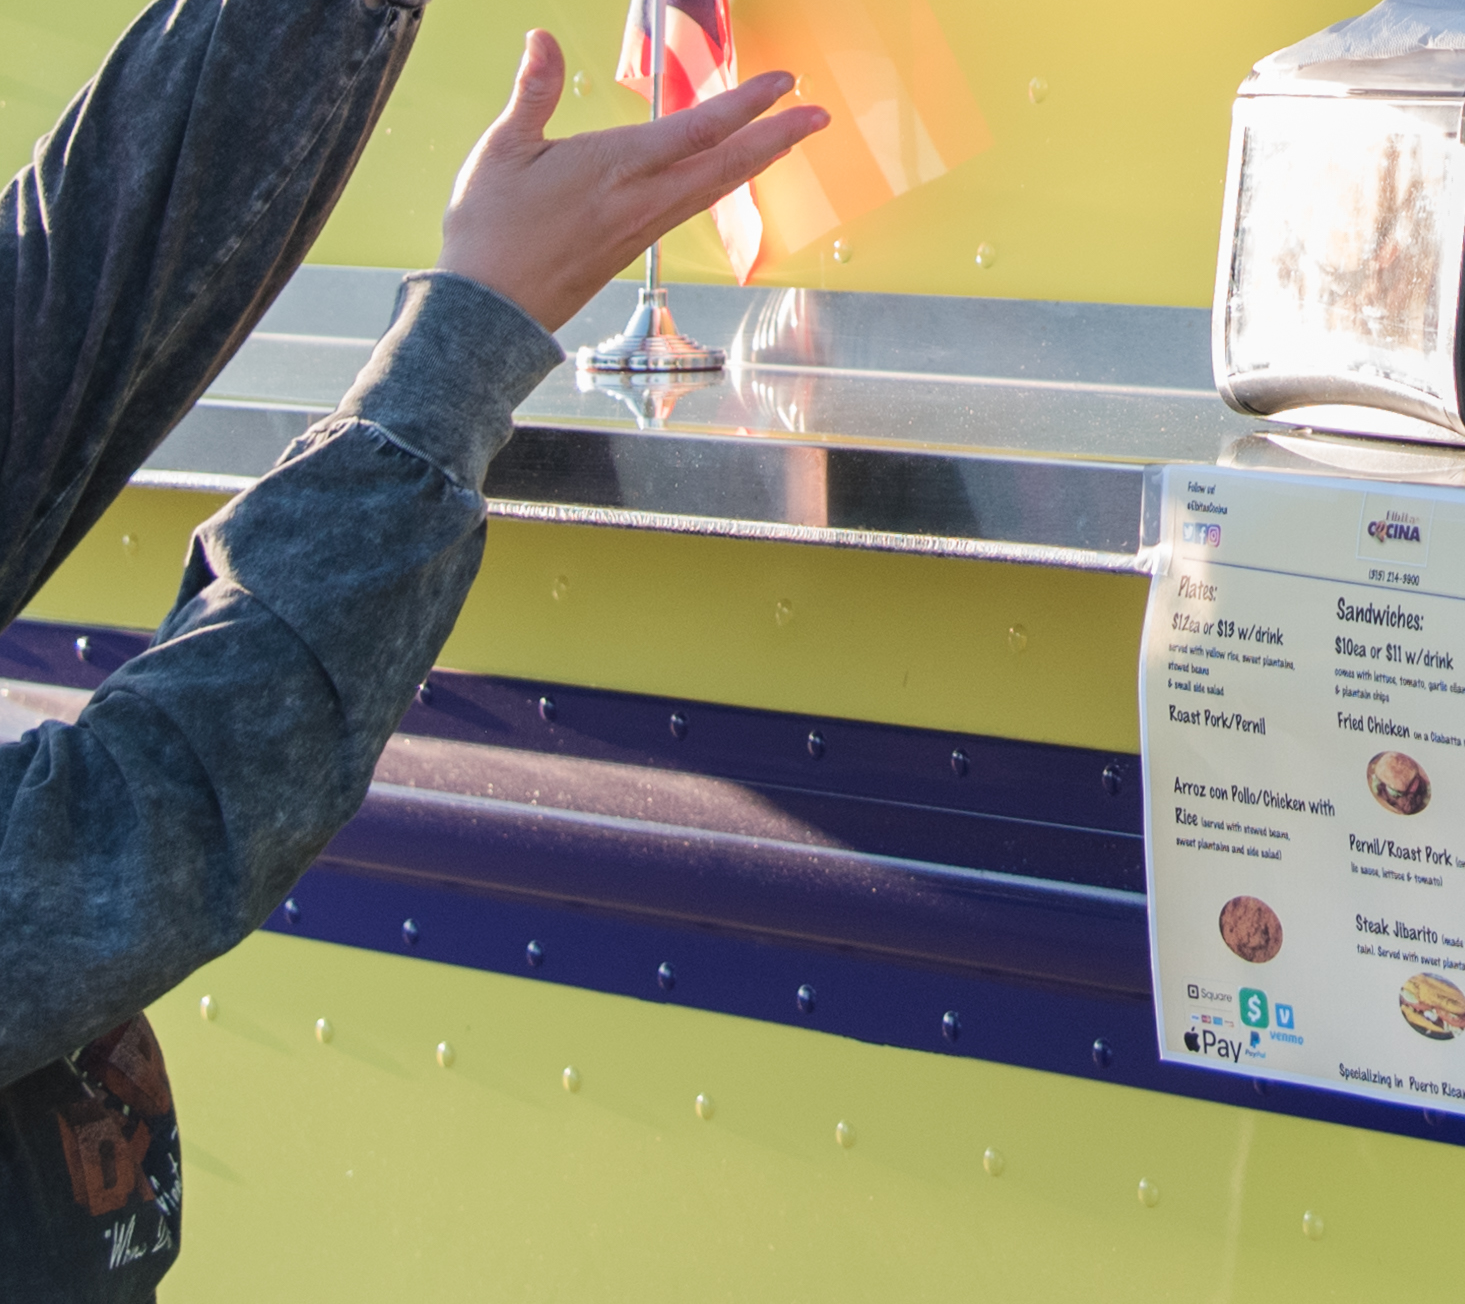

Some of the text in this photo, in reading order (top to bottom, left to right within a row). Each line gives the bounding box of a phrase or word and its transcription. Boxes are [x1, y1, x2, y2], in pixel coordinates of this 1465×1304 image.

[1368, 520, 1420, 542] COCINA
[1178, 575, 1218, 602] Plates:
[1172, 612, 1284, 645] $12ea or $13 w/drink
[1336, 596, 1424, 631] Sandwiches:
[1335, 635, 1454, 670] $10ea or $11 w/drink
[1169, 704, 1266, 735] Roast Pork/Pernil
[1337, 711, 1363, 732] Fried
[1367, 715, 1410, 739] Chicken
[1174, 776, 1335, 817] Arroz con Pollo/Chicken with
[1175, 807, 1198, 826] Rice
[1349, 833, 1422, 863] Pernil/Roast
[1425, 845, 1453, 867] Pork
[1355, 913, 1389, 936] Steak
[1393, 920, 1438, 944] Jibarito
[1200, 987, 1232, 1003] Square
[1202, 1029, 1242, 1063] Pay
[1270, 1030, 1304, 1045] venmo
[1339, 1062, 1392, 1089] Specializing
[1394, 1074, 1403, 1088] in
[1409, 1076, 1439, 1095] Puerto
